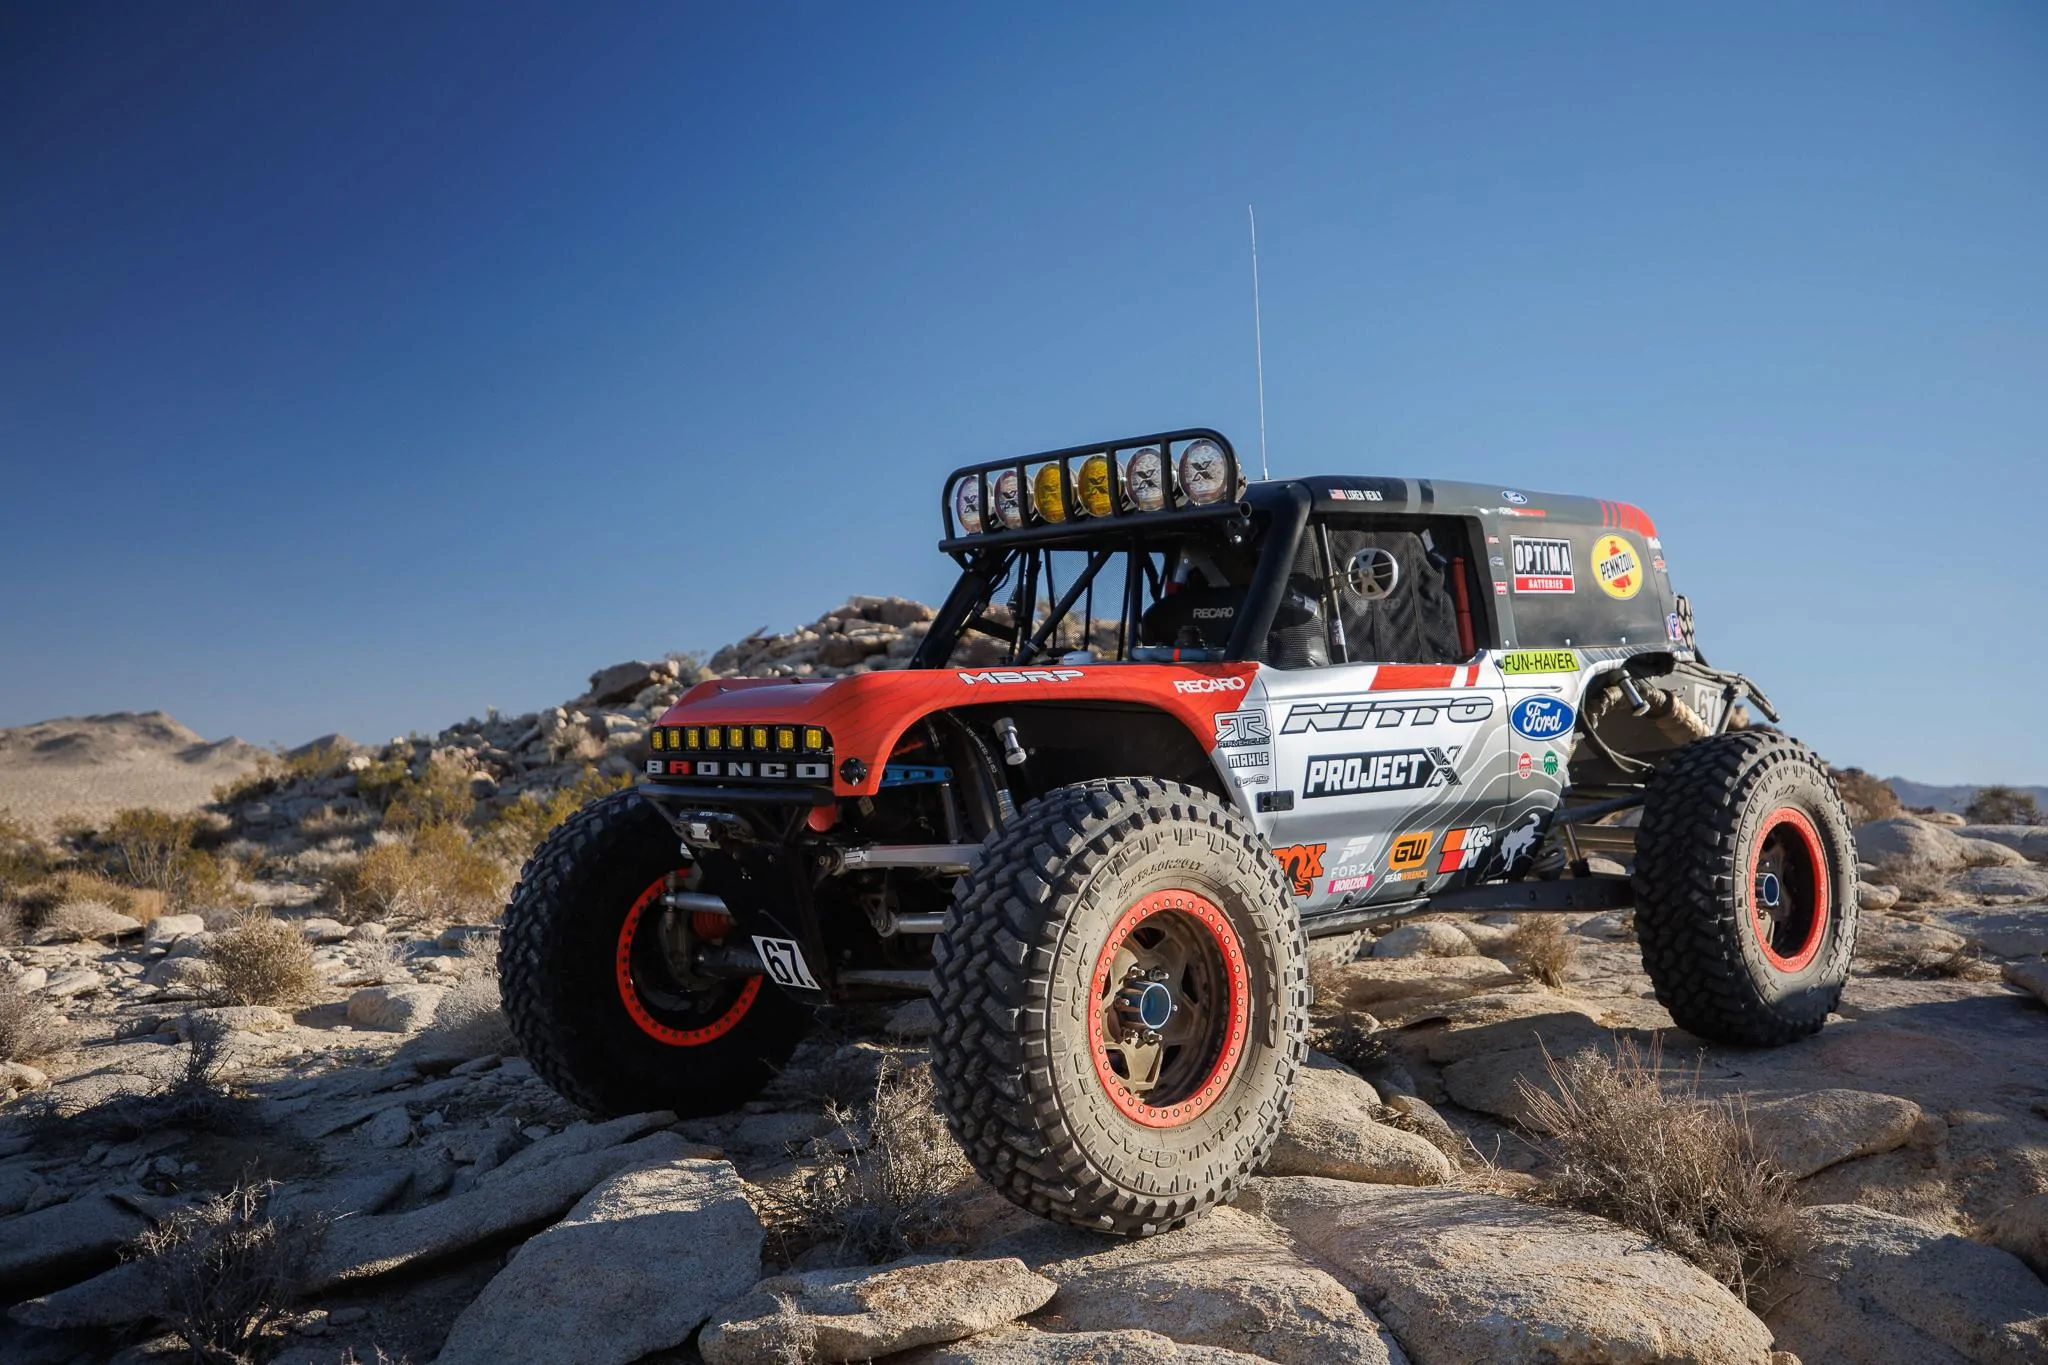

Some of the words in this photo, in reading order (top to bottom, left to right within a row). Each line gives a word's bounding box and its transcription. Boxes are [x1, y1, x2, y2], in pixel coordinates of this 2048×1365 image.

[1514, 543, 1571, 573] OPTIMA
[1600, 552, 1635, 581] PENNZOIL
[1528, 579, 1564, 590] BATTERIES
[1193, 607, 1234, 619] RECARO
[1504, 652, 1576, 672] FUN-HAVER
[958, 669, 1085, 685] MBRP
[1173, 676, 1246, 694] RECARO
[1279, 696, 1494, 736] NITTO
[1522, 700, 1563, 734] Ford
[1228, 752, 1270, 768] MAHLE
[1306, 752, 1427, 794] PROJECT
[1426, 744, 1463, 788] X
[646, 760, 829, 779] BRONCO
[1330, 862, 1376, 879] FORZA
[1384, 869, 1428, 883] GEARWRENCH
[1332, 875, 1370, 893] HORIZON
[761, 938, 807, 986] 67
